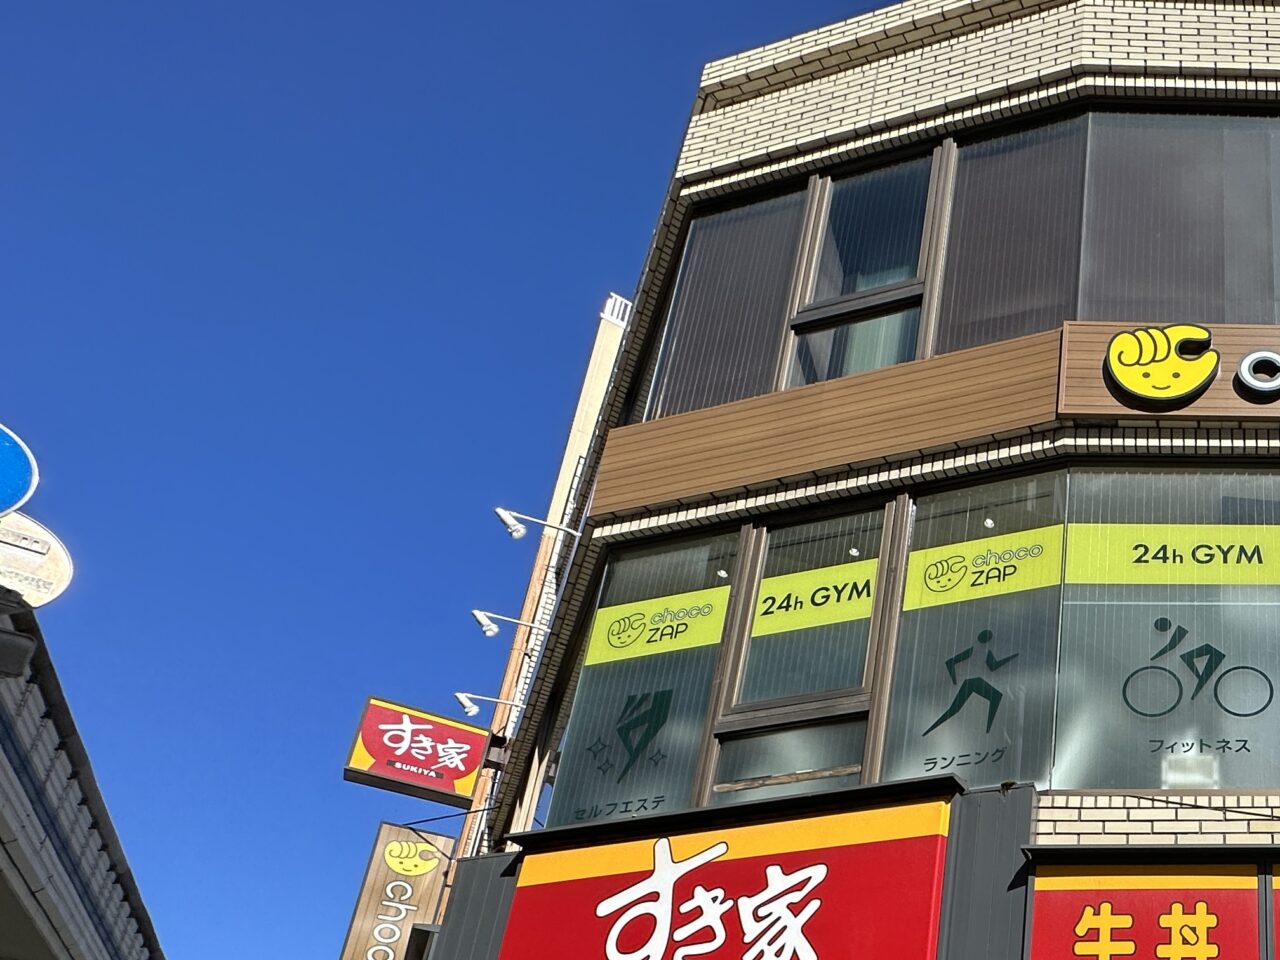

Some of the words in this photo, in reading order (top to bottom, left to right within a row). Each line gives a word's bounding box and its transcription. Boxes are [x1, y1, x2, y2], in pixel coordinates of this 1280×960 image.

[970, 543, 1045, 569] choco
[1132, 543, 1184, 566] 24h
[1190, 543, 1264, 567] GYM
[969, 563, 1018, 588] ZAP
[759, 593, 804, 617] 24h
[810, 578, 872, 607] GYM
[649, 602, 714, 625] choco
[646, 622, 689, 645] ZAP
[378, 714, 471, 772] すき家
[1148, 738, 1252, 754] フィットネス
[394, 760, 437, 779] SUKIYA
[923, 745, 1008, 773] ランニング
[573, 795, 666, 822] セルフエステ
